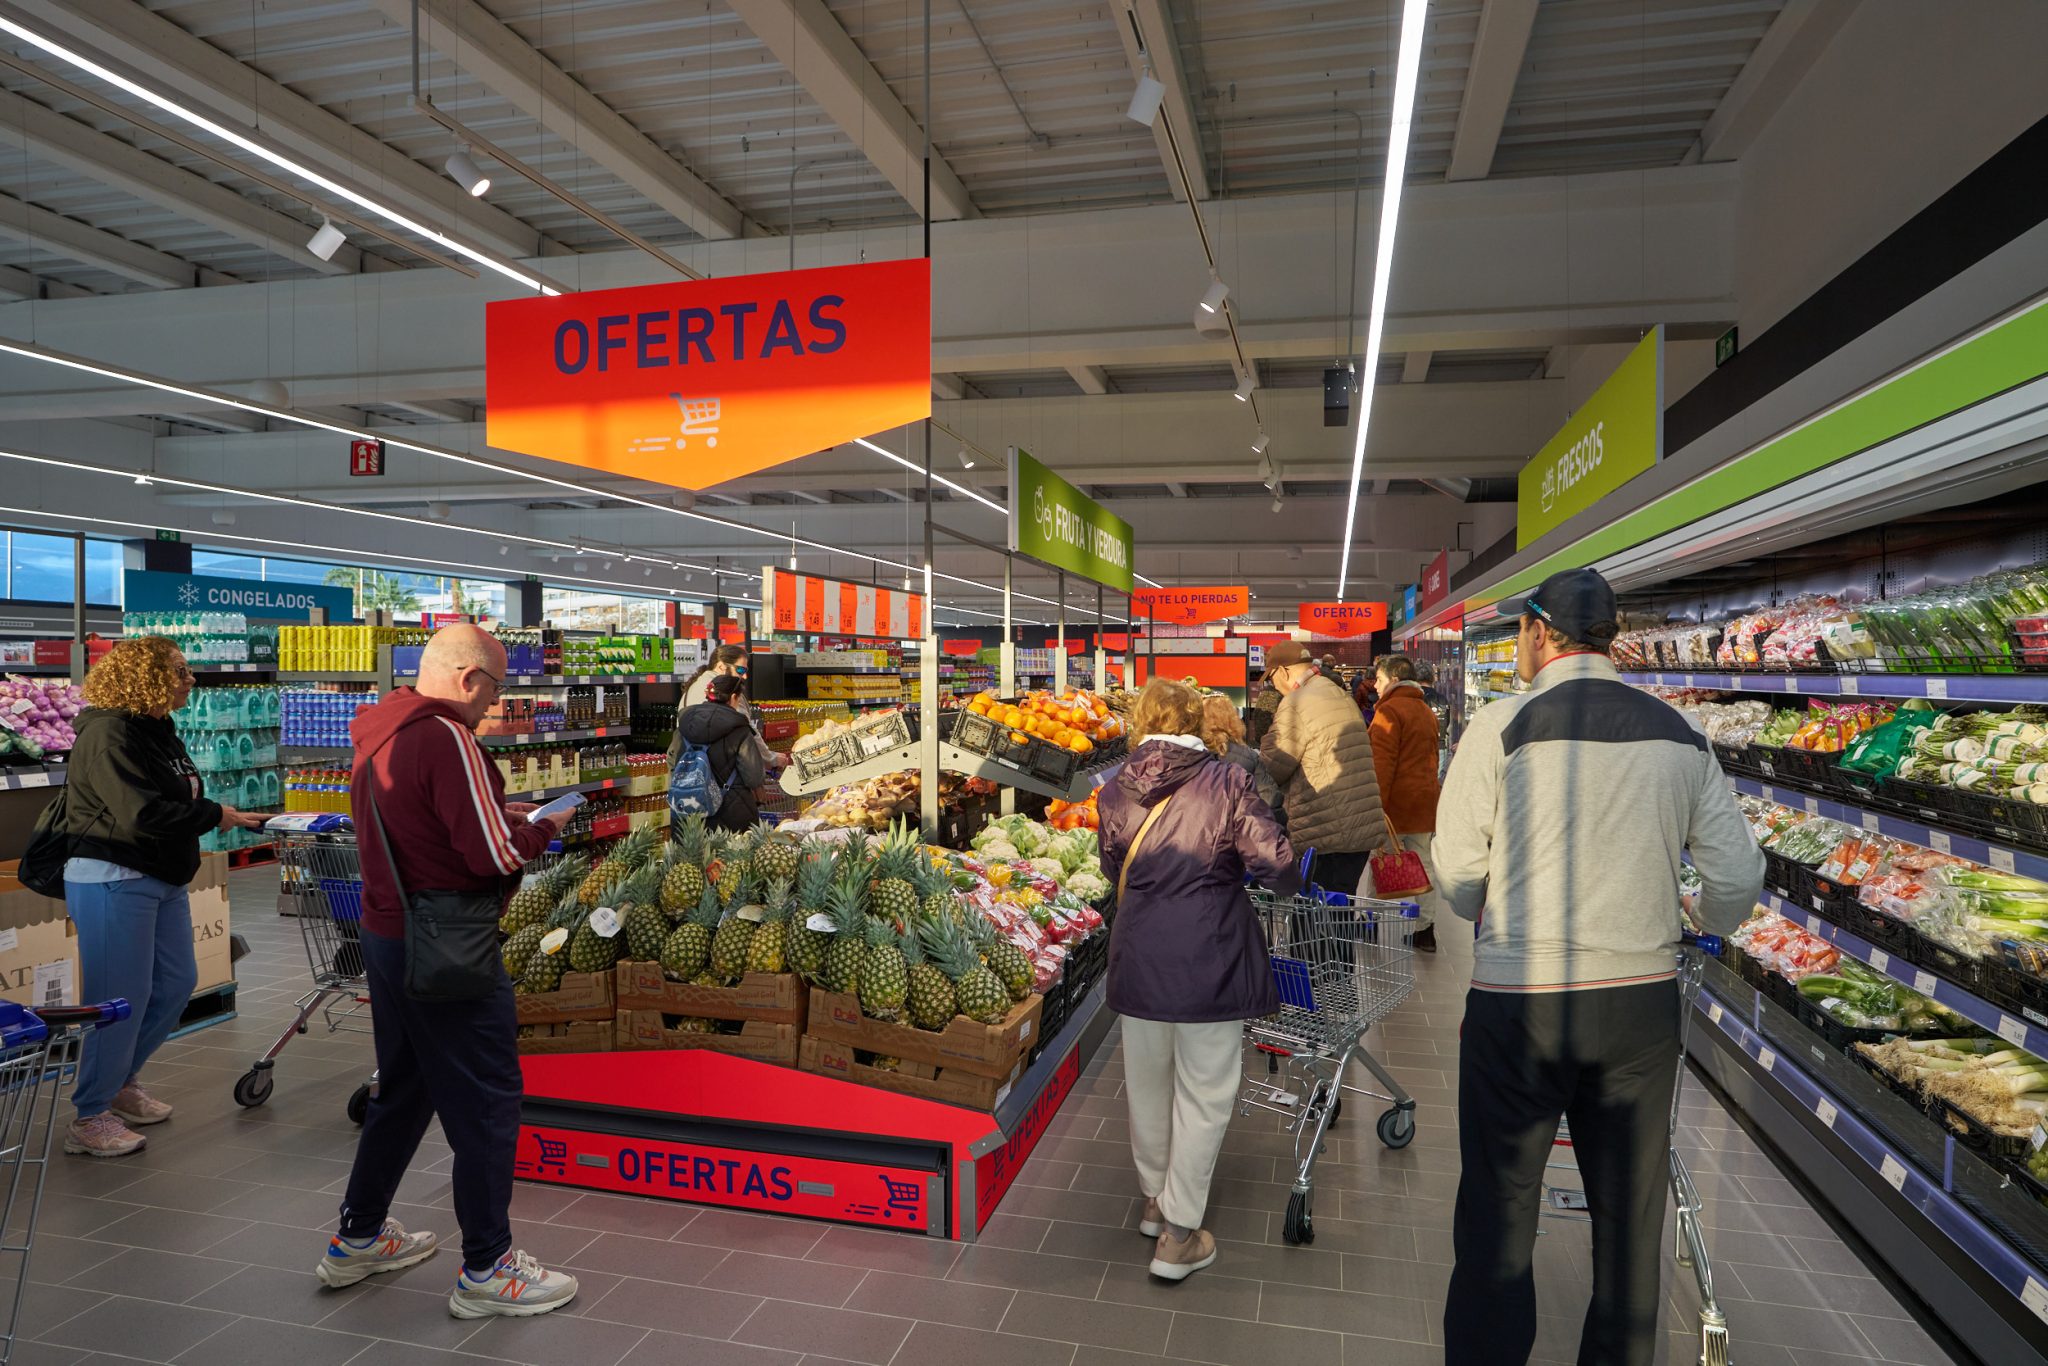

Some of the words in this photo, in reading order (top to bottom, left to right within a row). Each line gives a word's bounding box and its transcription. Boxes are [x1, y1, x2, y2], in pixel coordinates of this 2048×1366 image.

[554, 295, 846, 375] OFERTAS
[1556, 421, 1604, 496] FRESCOS
[1055, 503, 1086, 550] FRUTA
[1086, 521, 1093, 553] Y
[1094, 525, 1127, 569] VERDURA
[208, 588, 316, 609] CONGELADOS
[1141, 595, 1156, 605] NO
[1158, 595, 1171, 604] TE
[1174, 595, 1188, 604] LO
[1191, 594, 1238, 604] PIERDAS
[1313, 607, 1372, 618] OFERTAS
[639, 975, 661, 986] Dole
[834, 1007, 857, 1020] Dole
[638, 1026, 660, 1037] Dole
[823, 1054, 847, 1068] Dole
[617, 1147, 793, 1201] OFERTAS
[498, 1277, 528, 1300] N
